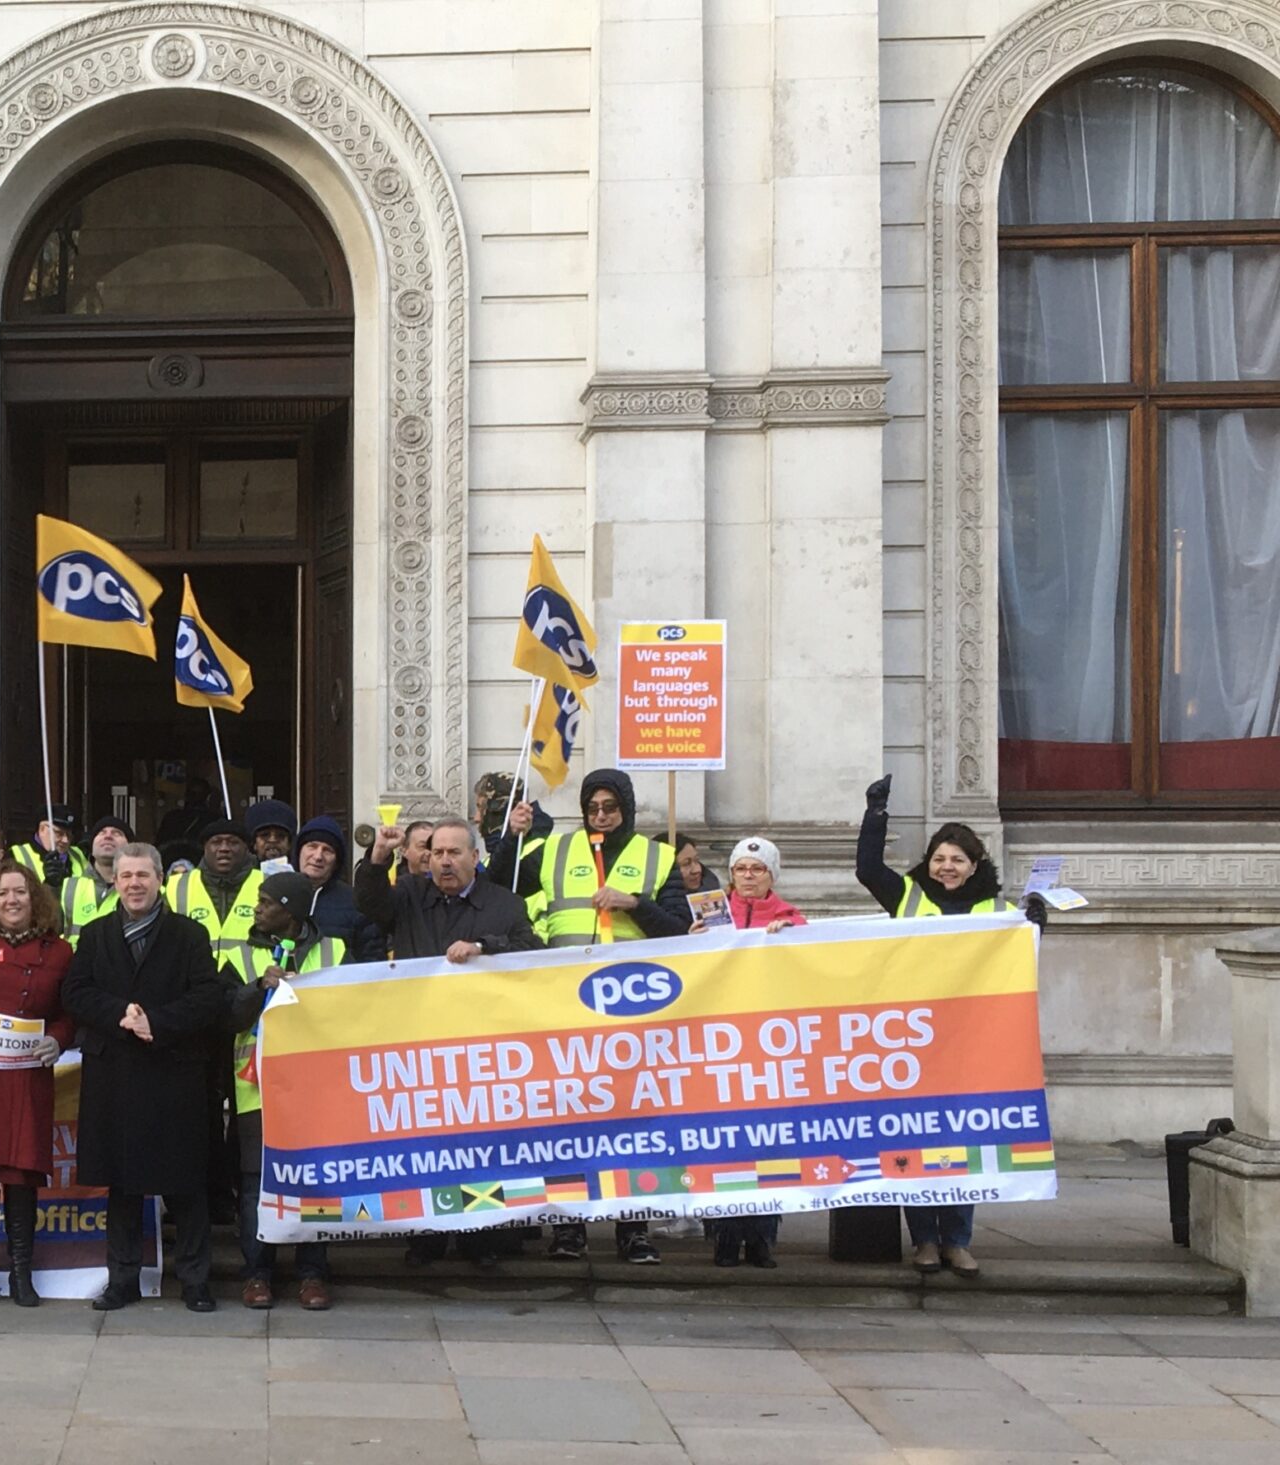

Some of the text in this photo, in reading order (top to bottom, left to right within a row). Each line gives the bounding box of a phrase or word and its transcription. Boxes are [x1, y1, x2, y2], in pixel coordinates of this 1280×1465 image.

[53, 561, 141, 619] pcs
[659, 627, 685, 641] pcs
[635, 649, 708, 667] We speak
[650, 666, 692, 680] many
[632, 679, 709, 696] languages
[624, 695, 718, 711] but through
[635, 710, 707, 723] our union
[639, 725, 702, 738] we have
[635, 739, 707, 753] one voice
[592, 971, 672, 1015] pcs
[349, 1008, 935, 1094] UNITED WORLD OF PCS
[367, 1051, 921, 1134] MEMBERS AT THE FCO
[272, 1105, 1040, 1185] WE SPEAK MANY LANGUAGES, BUT WE HAVE ONE VOICE
[620, 1206, 677, 1221] Union
[810, 1187, 1001, 1209] #InterserveStrikers
